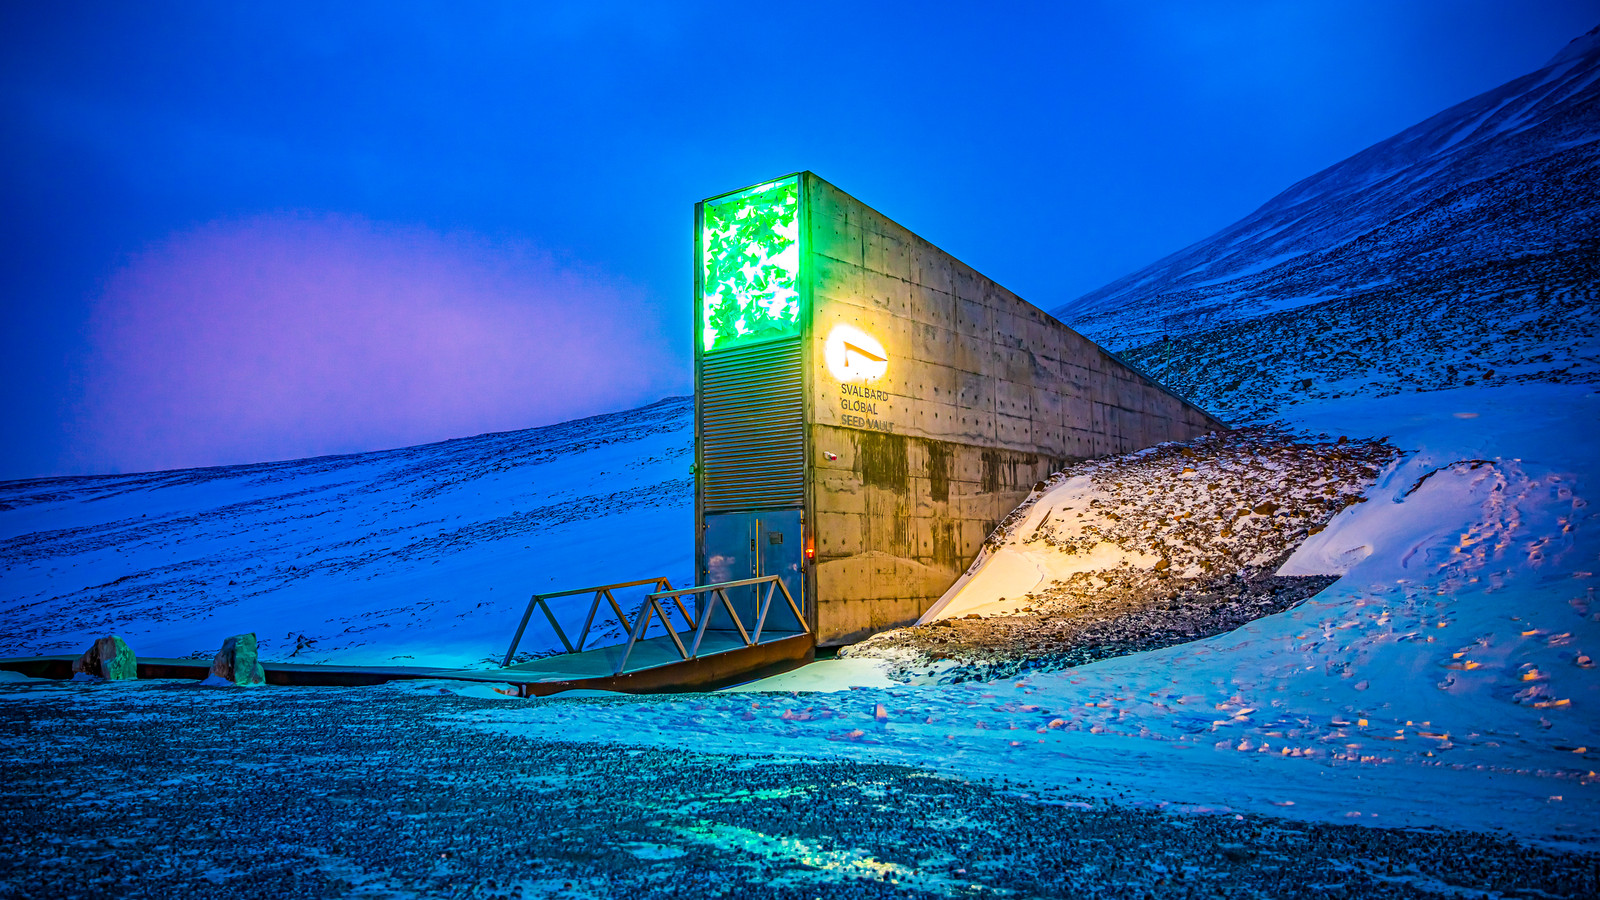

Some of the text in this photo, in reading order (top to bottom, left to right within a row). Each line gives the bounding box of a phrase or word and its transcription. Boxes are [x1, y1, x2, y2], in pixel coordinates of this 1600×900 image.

[841, 383, 888, 401] SVALBARD
[841, 399, 878, 415] GLOBAL
[841, 414, 894, 432] SEED VAULT
